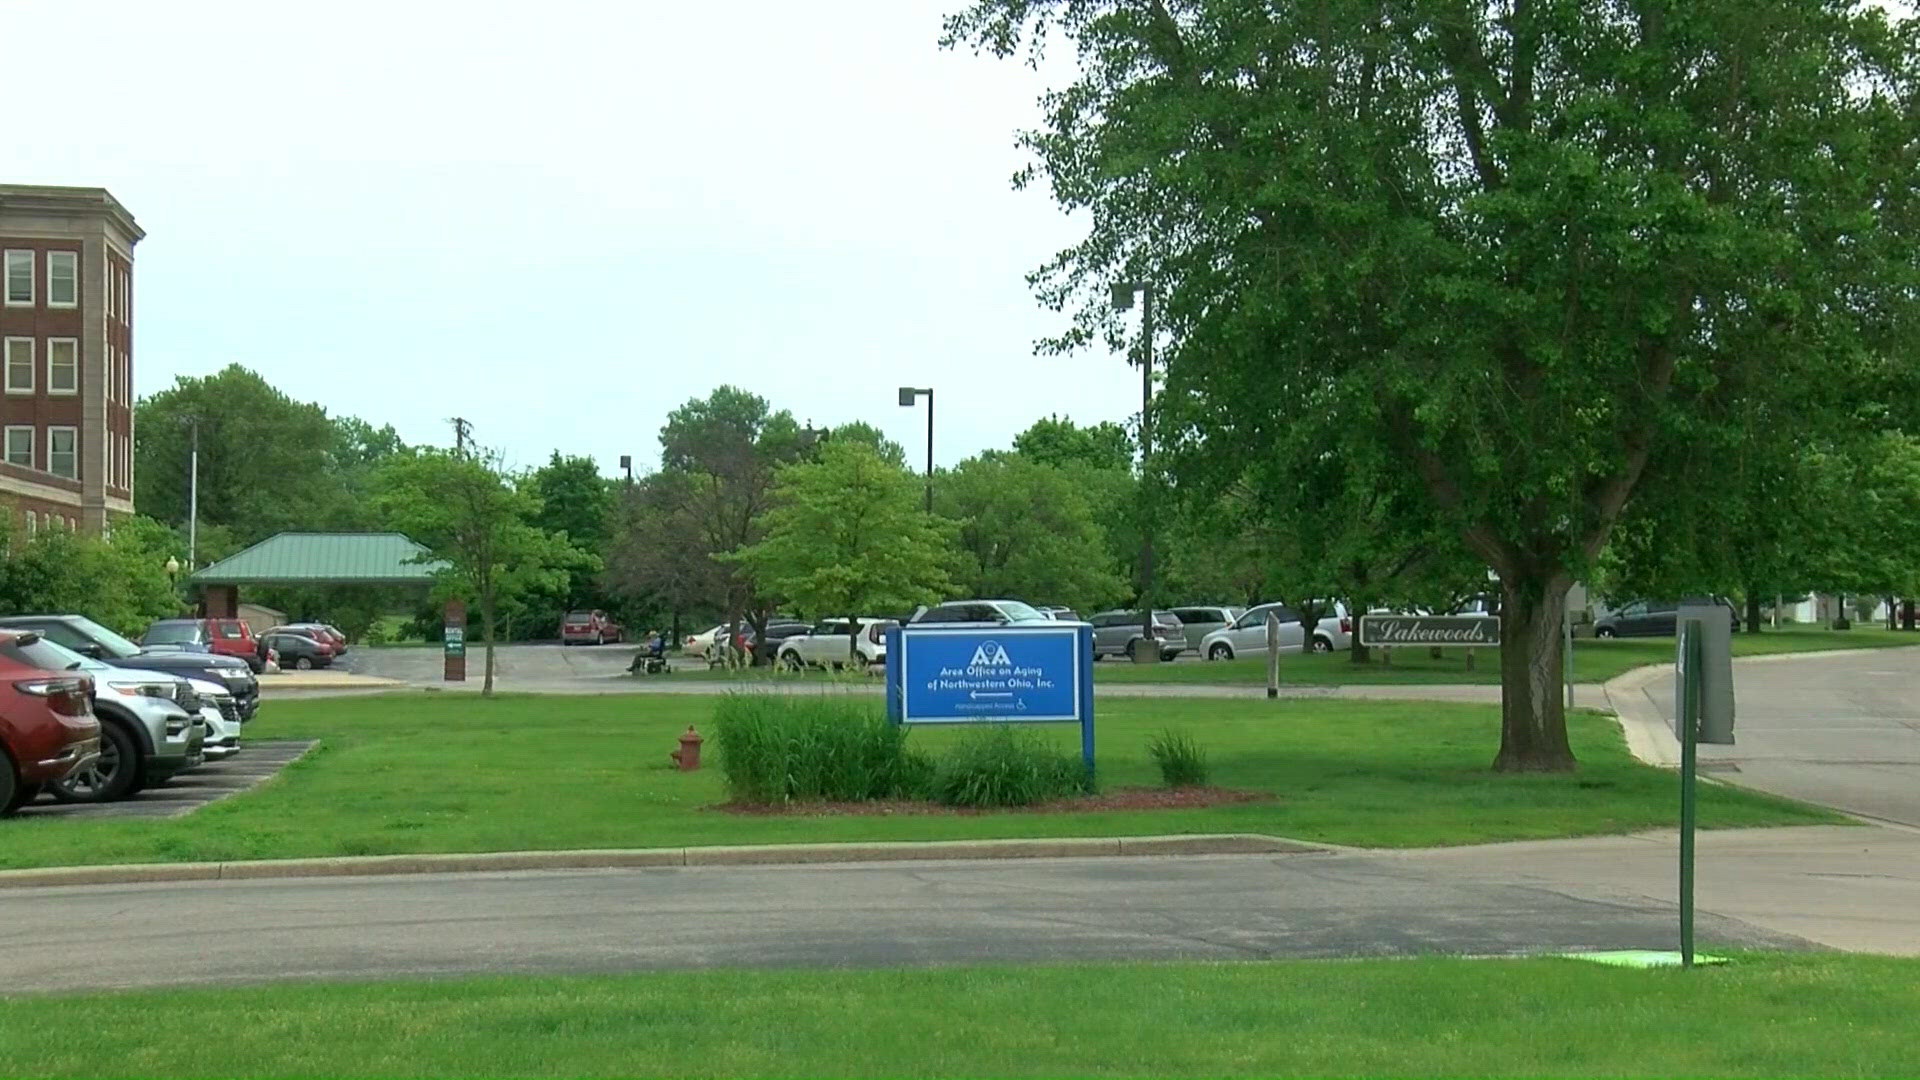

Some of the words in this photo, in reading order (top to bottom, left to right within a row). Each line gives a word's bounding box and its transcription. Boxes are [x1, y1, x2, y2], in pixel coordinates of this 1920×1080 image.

[1380, 620, 1484, 641] Lakewoods
[940, 667, 963, 676] Area
[966, 666, 994, 677] Office
[1013, 666, 1042, 676] Aging
[927, 679, 937, 691] of
[940, 680, 1005, 689] Northwestern
[1007, 679, 1034, 689] Ohio,
[1037, 679, 1055, 688] Inc.
